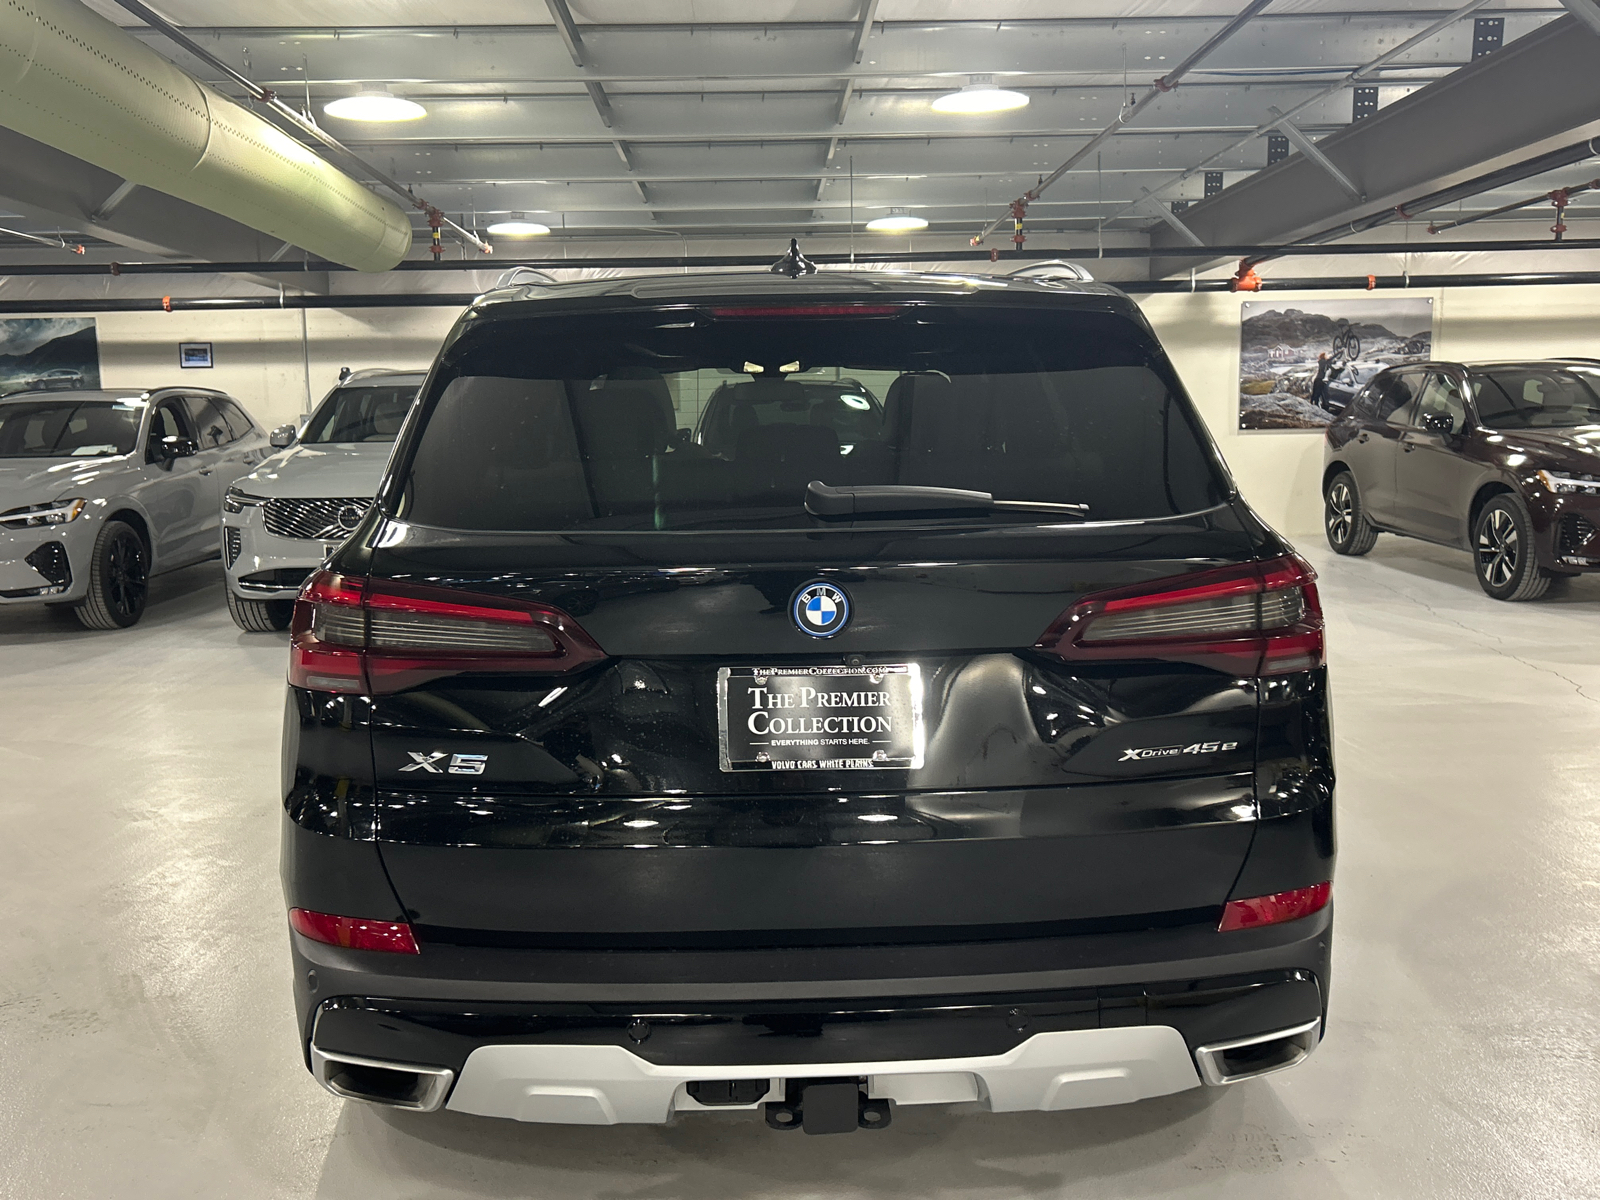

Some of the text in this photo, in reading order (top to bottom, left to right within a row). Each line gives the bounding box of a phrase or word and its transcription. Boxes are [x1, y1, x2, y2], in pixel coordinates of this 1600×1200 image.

[801, 587, 842, 603] BMW
[747, 686, 891, 709] THE PREMIER
[747, 711, 892, 735] COLLECTION
[398, 751, 488, 775] X5
[771, 760, 796, 769] VOLVO
[819, 760, 844, 769] WHITE
[845, 759, 874, 768] PLAINS
